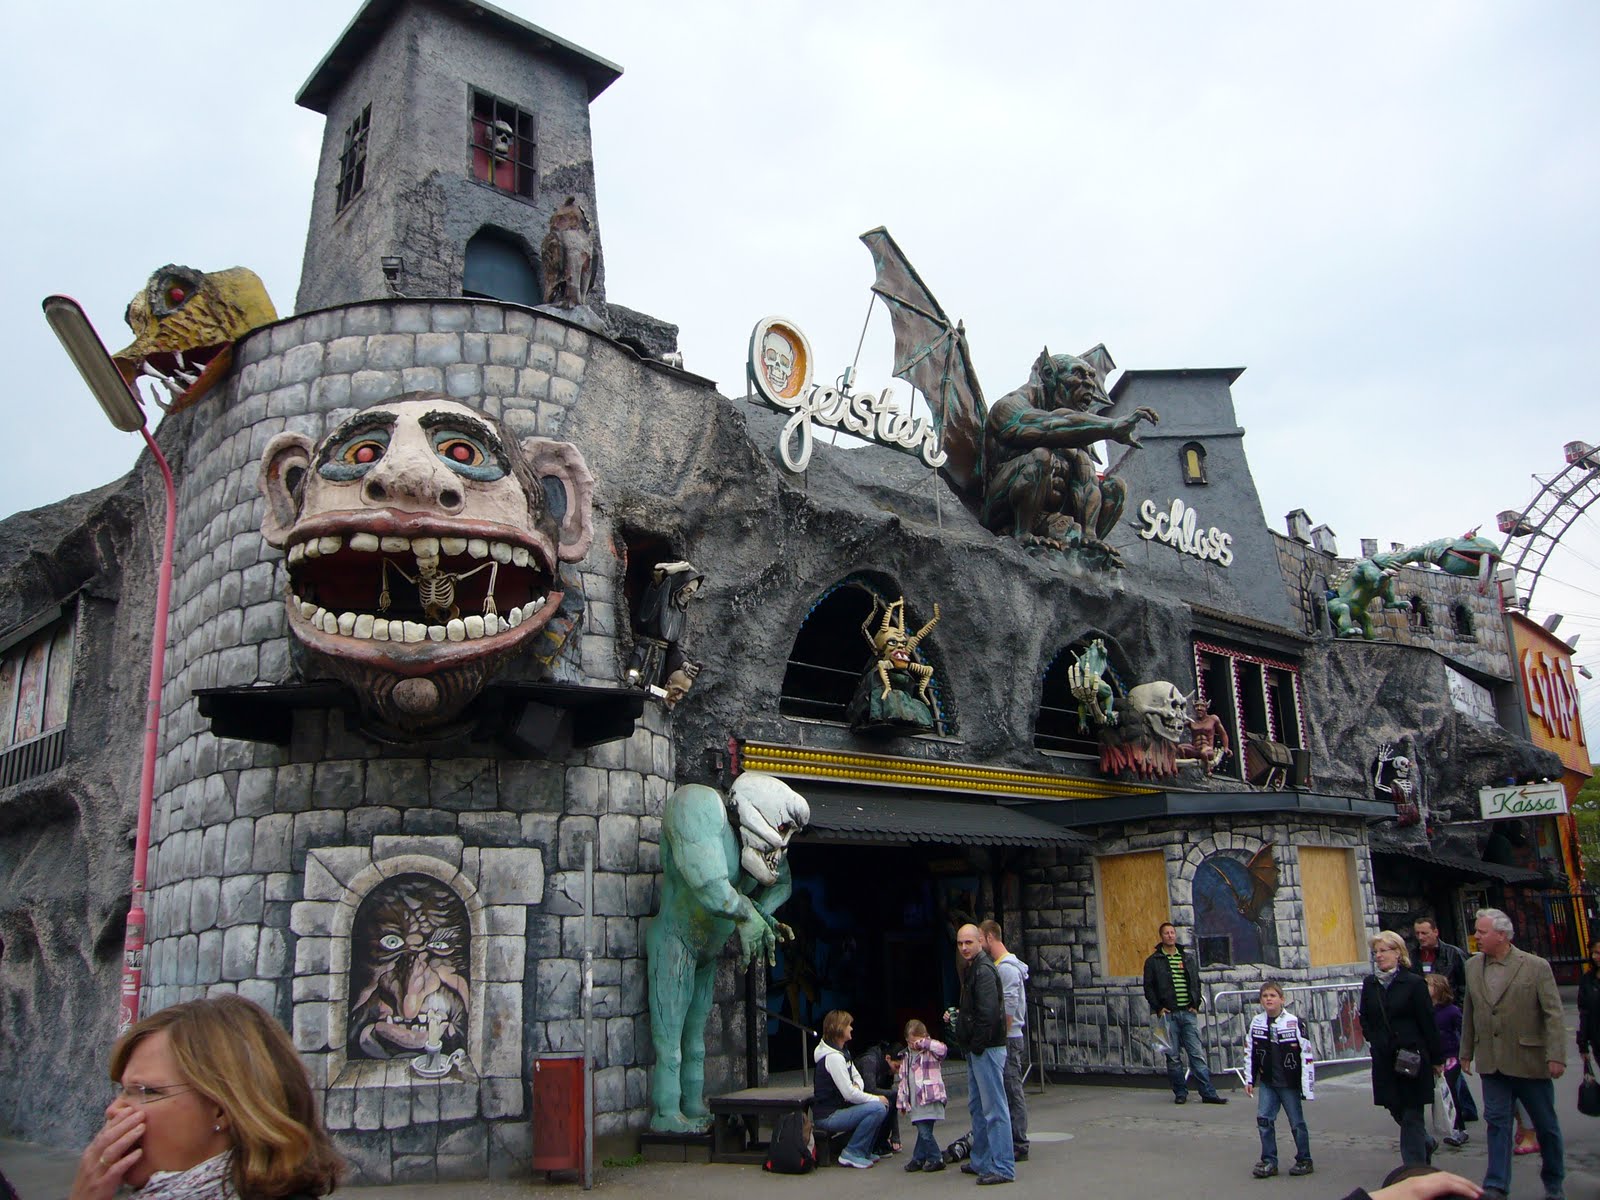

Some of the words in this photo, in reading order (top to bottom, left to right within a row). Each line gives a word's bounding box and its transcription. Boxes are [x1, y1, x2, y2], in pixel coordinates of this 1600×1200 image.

[1140, 498, 1234, 567] Schloss
[1489, 790, 1557, 815] Kassa
[1284, 1052, 1297, 1070] 4
